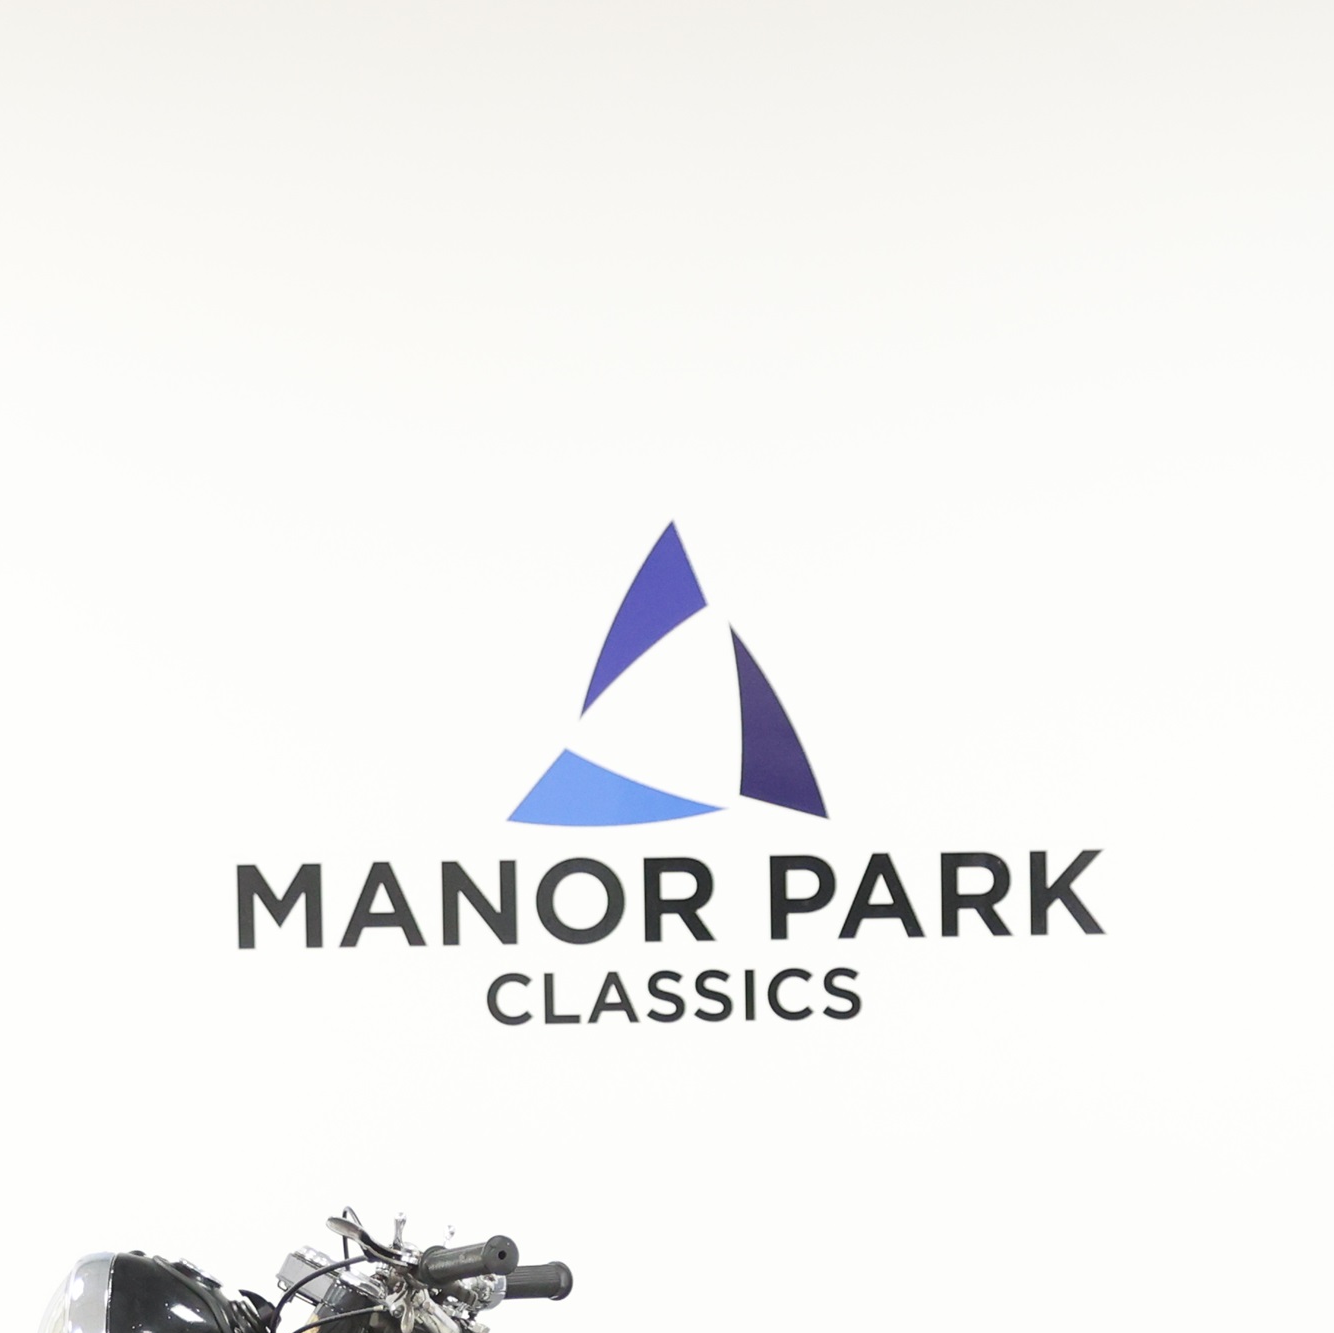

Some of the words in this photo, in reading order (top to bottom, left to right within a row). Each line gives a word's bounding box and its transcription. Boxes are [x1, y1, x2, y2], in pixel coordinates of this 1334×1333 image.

[236, 856, 716, 950] MANOR
[769, 849, 1105, 940] PARK
[486, 967, 862, 1026] CLASSICS
